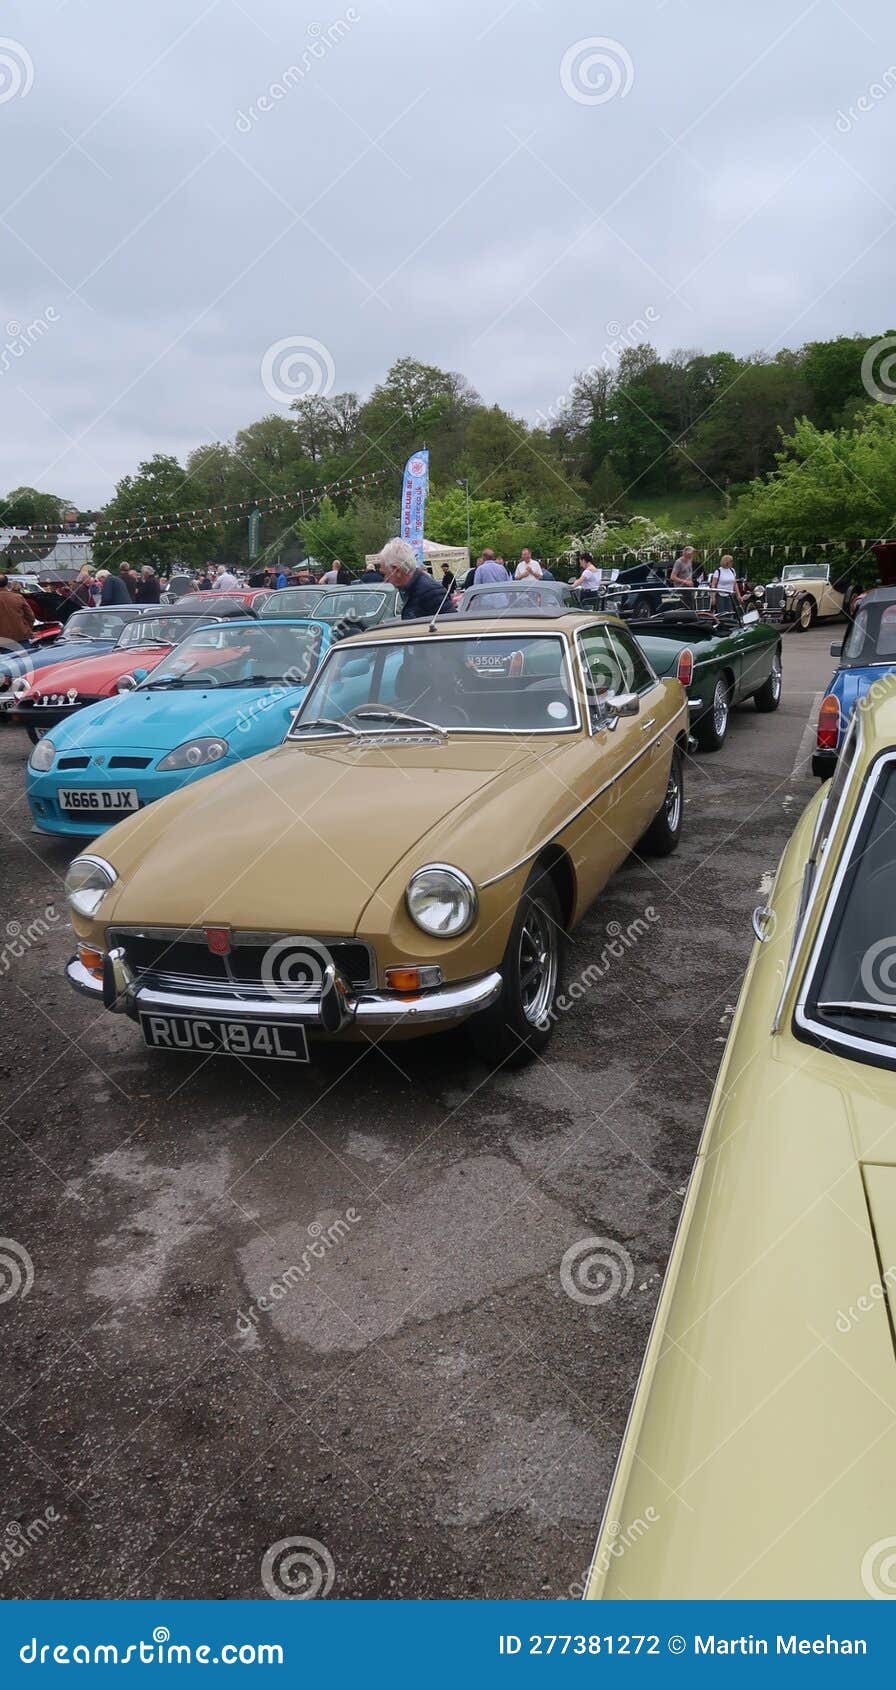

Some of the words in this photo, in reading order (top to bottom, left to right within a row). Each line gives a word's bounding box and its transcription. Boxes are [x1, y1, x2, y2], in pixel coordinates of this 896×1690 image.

[63, 792, 99, 808] X666
[101, 792, 132, 808] DJX
[150, 1017, 215, 1049] RUC
[220, 1023, 297, 1057] 194L
